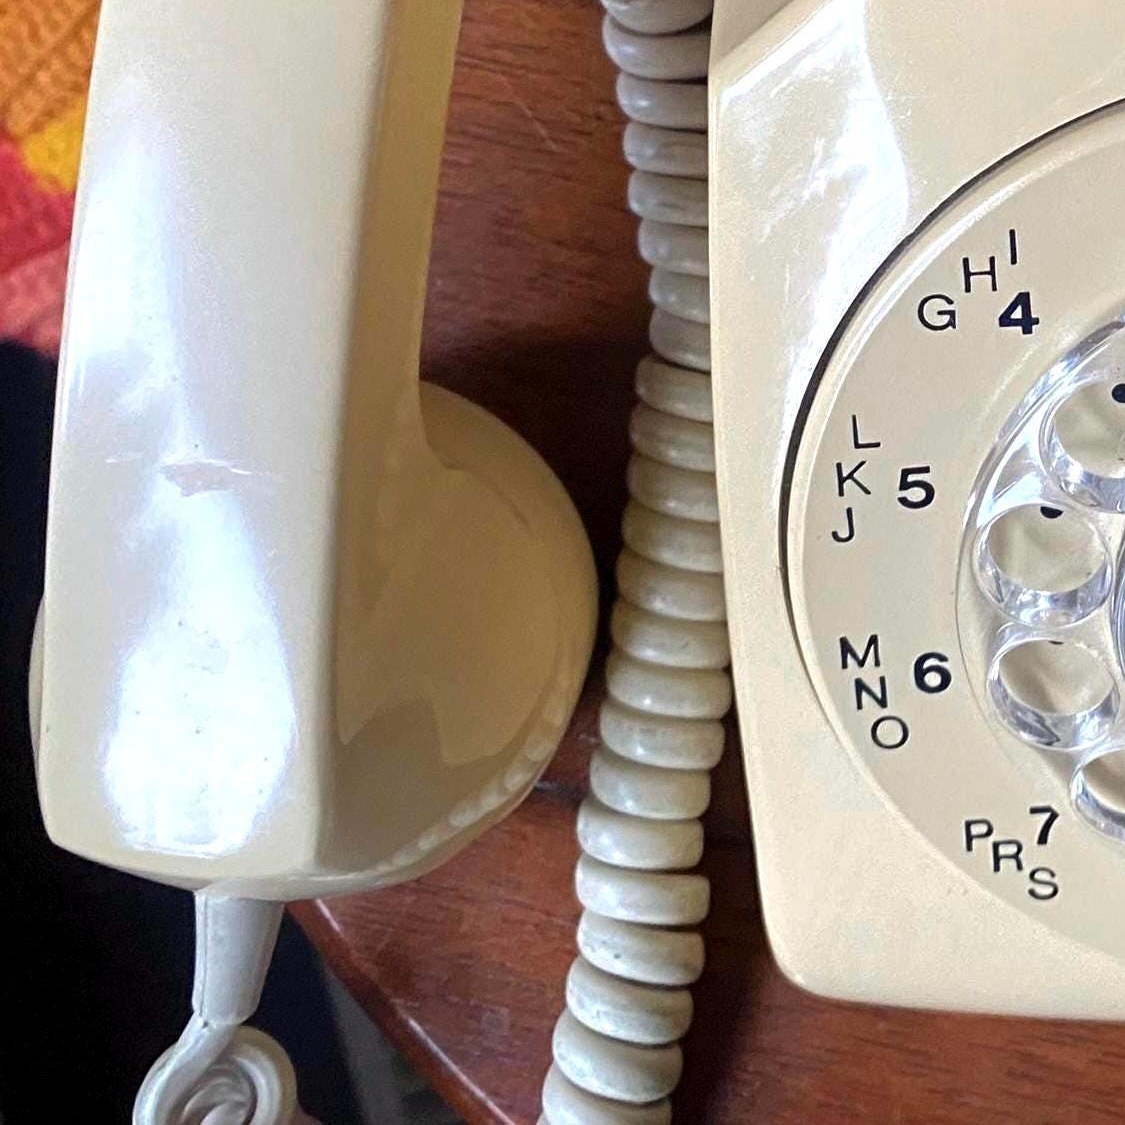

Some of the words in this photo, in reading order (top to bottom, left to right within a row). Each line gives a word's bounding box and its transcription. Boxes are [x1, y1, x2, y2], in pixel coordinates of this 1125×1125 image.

[998, 290, 1040, 335] 4
[897, 465, 936, 510] 5
[913, 651, 952, 695] 6
[1029, 805, 1060, 846] 7
